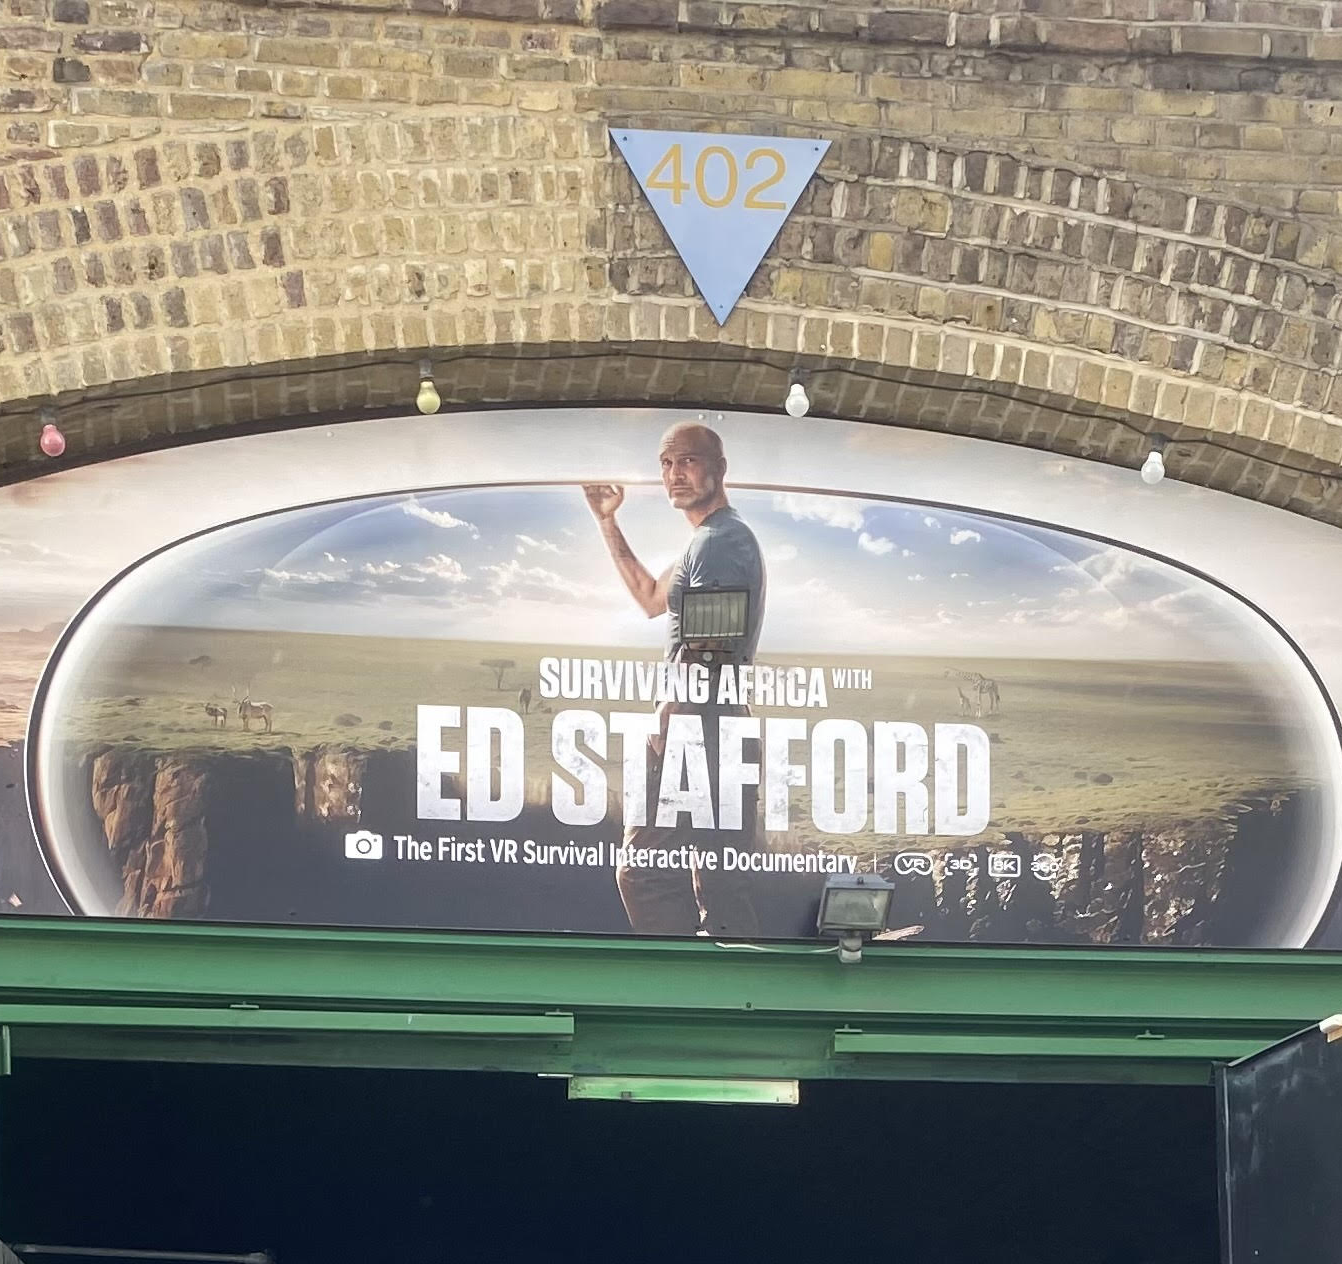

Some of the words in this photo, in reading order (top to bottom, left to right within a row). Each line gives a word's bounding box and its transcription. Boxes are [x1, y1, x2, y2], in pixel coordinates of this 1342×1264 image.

[645, 143, 788, 210] 402
[539, 656, 710, 704] SURVIVING
[716, 663, 828, 708] AFRICA
[831, 667, 873, 690] WITH
[416, 703, 525, 822] ED
[551, 709, 991, 836] STAFFORD
[393, 834, 432, 861] The
[438, 836, 486, 863] First
[490, 838, 518, 864] VR
[523, 840, 604, 867] Survival
[609, 842, 718, 870] Interactive
[723, 846, 859, 875] Documentary
[902, 857, 926, 869] VR
[949, 859, 973, 870] 3D
